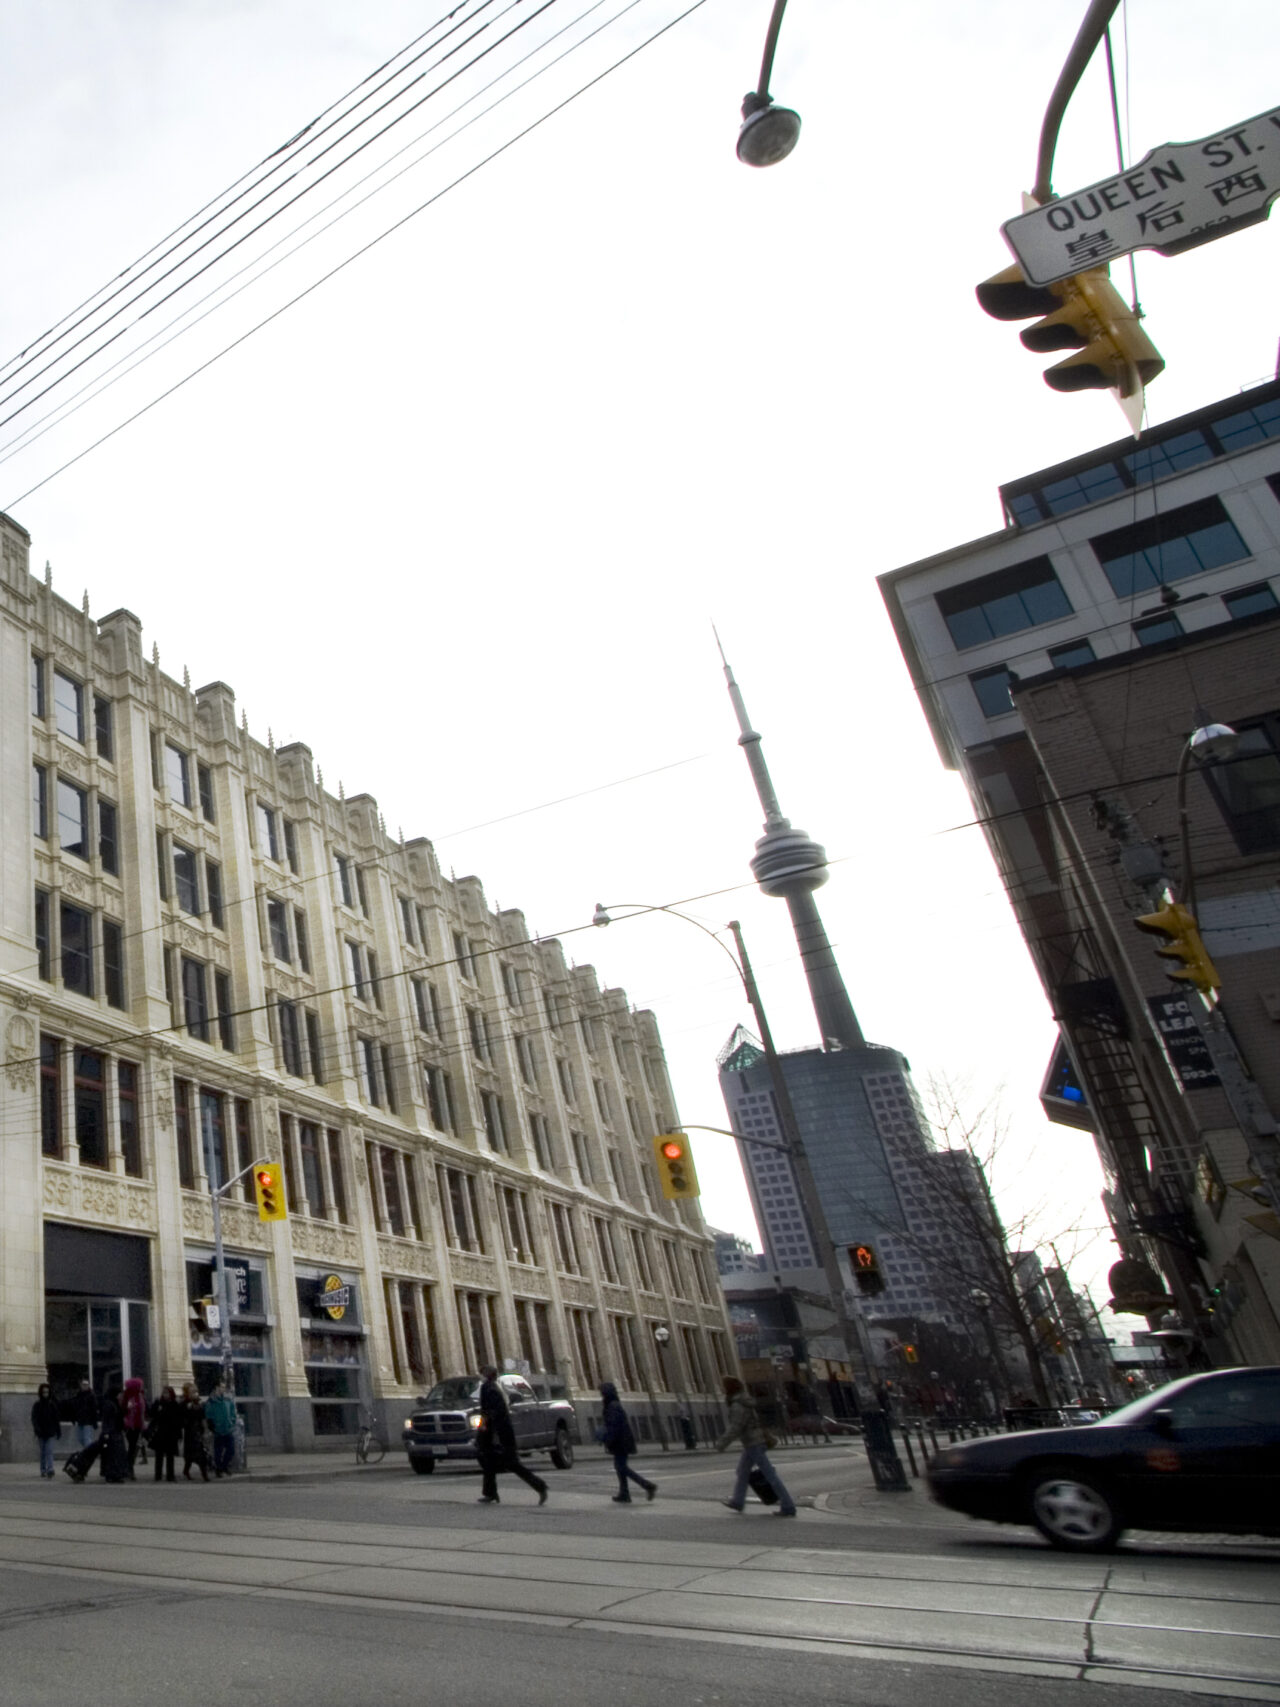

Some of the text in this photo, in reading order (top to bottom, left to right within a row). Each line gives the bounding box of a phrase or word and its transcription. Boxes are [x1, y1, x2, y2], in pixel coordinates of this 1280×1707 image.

[1046, 159, 1186, 232] QUEEN
[1201, 129, 1265, 168] ST.
[1162, 1000, 1190, 1016] FO
[1158, 1015, 1196, 1032] LEA
